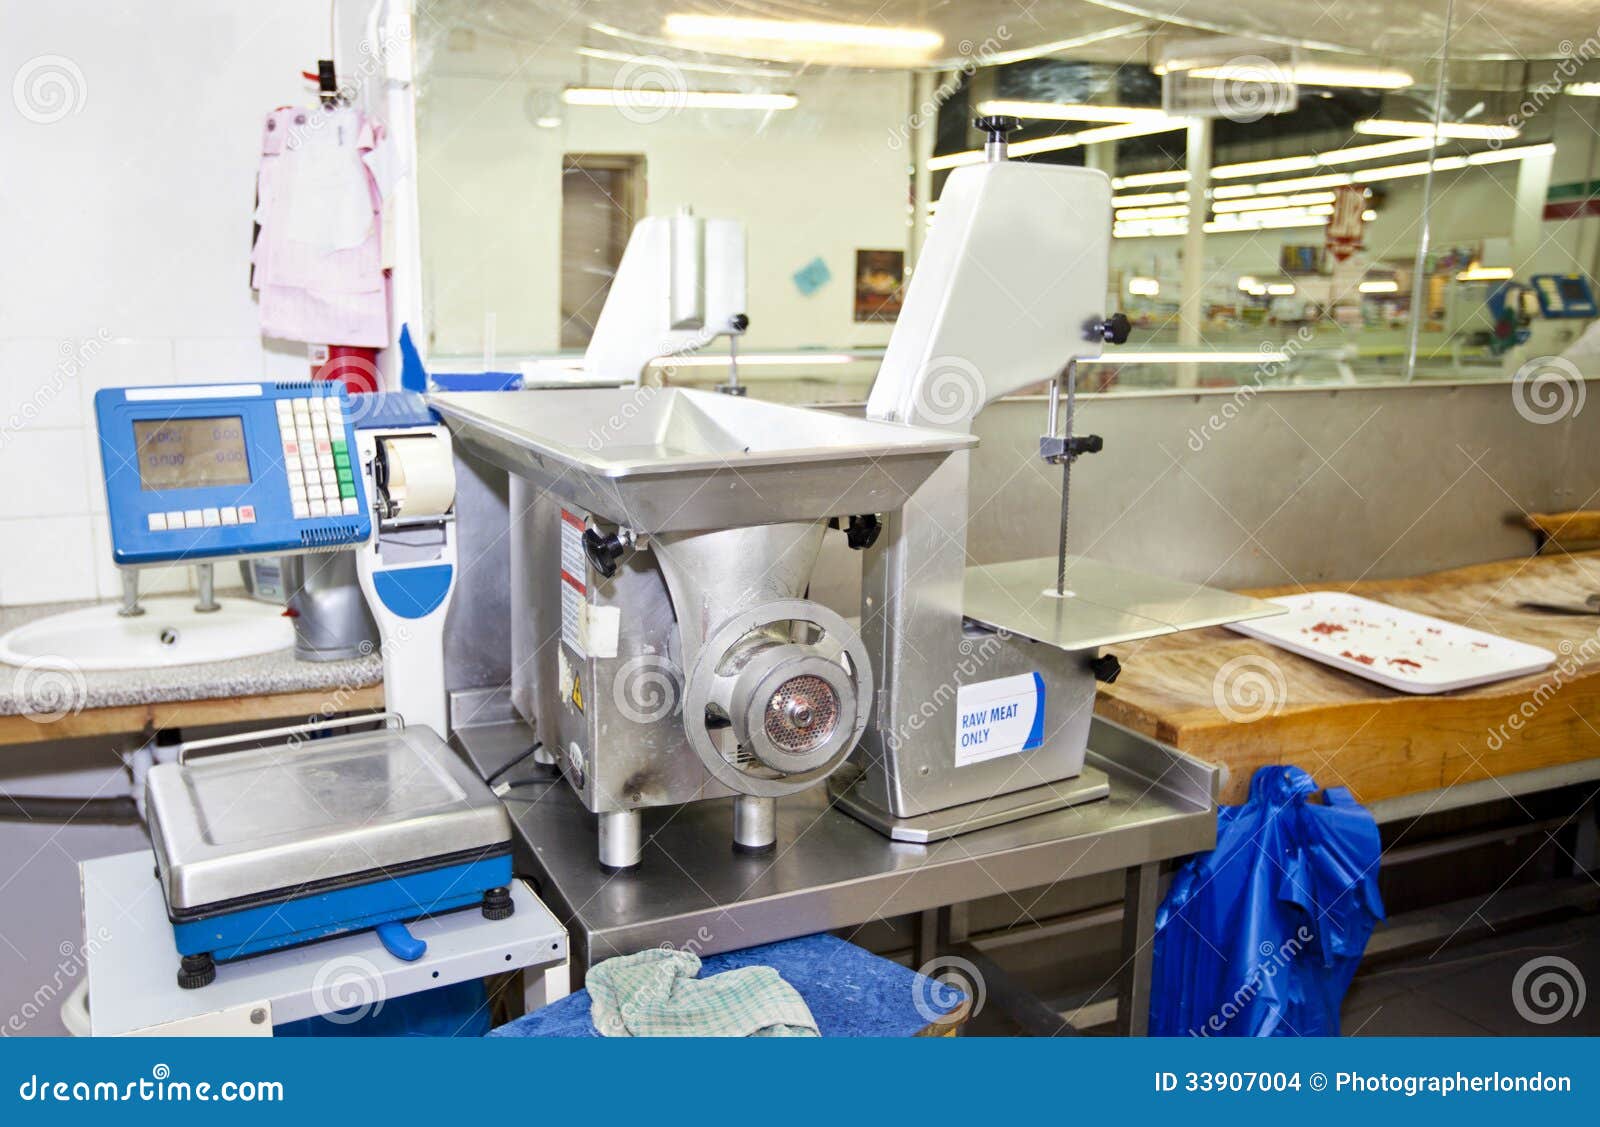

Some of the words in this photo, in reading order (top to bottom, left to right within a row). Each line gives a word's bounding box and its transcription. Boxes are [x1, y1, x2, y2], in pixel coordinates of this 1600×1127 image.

[962, 710, 988, 729] RAW
[990, 703, 1019, 723] MEAT
[961, 728, 990, 747] ONLY
